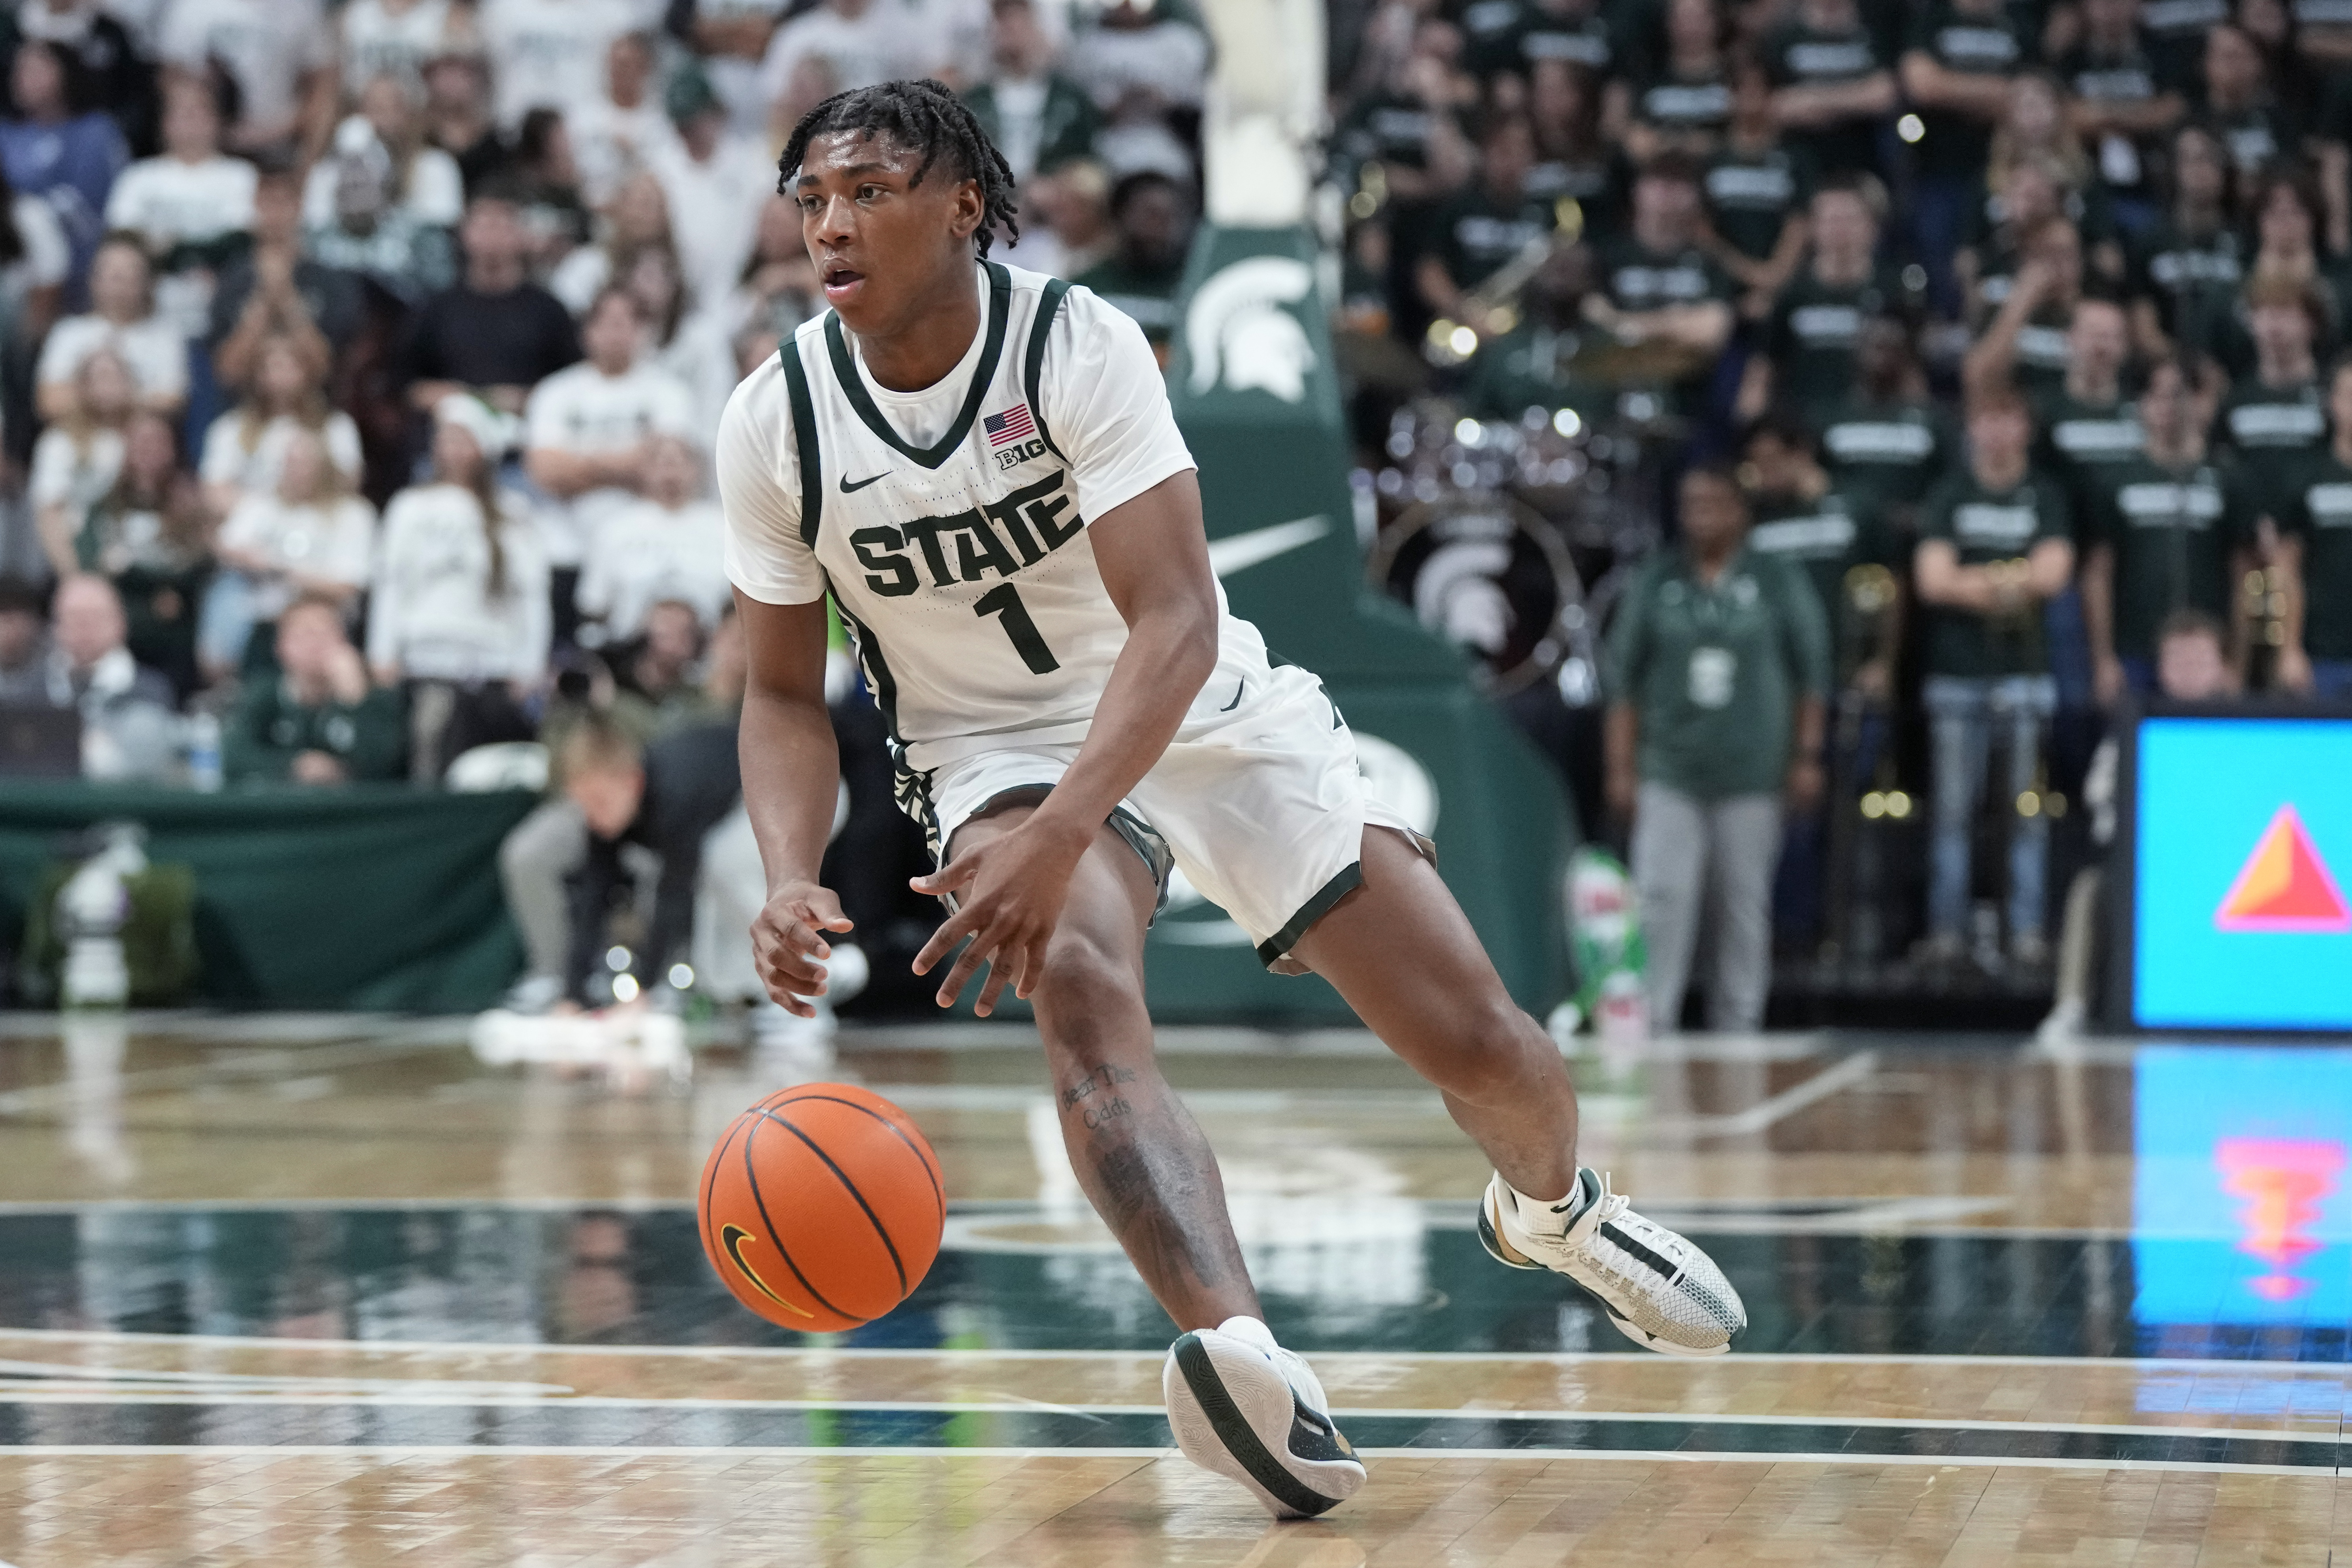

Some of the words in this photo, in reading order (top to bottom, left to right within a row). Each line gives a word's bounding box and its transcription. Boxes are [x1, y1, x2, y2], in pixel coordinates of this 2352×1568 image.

[849, 469, 1084, 597] STATE
[973, 582, 1061, 675] 1
[1084, 1096, 1132, 1129] Odds
